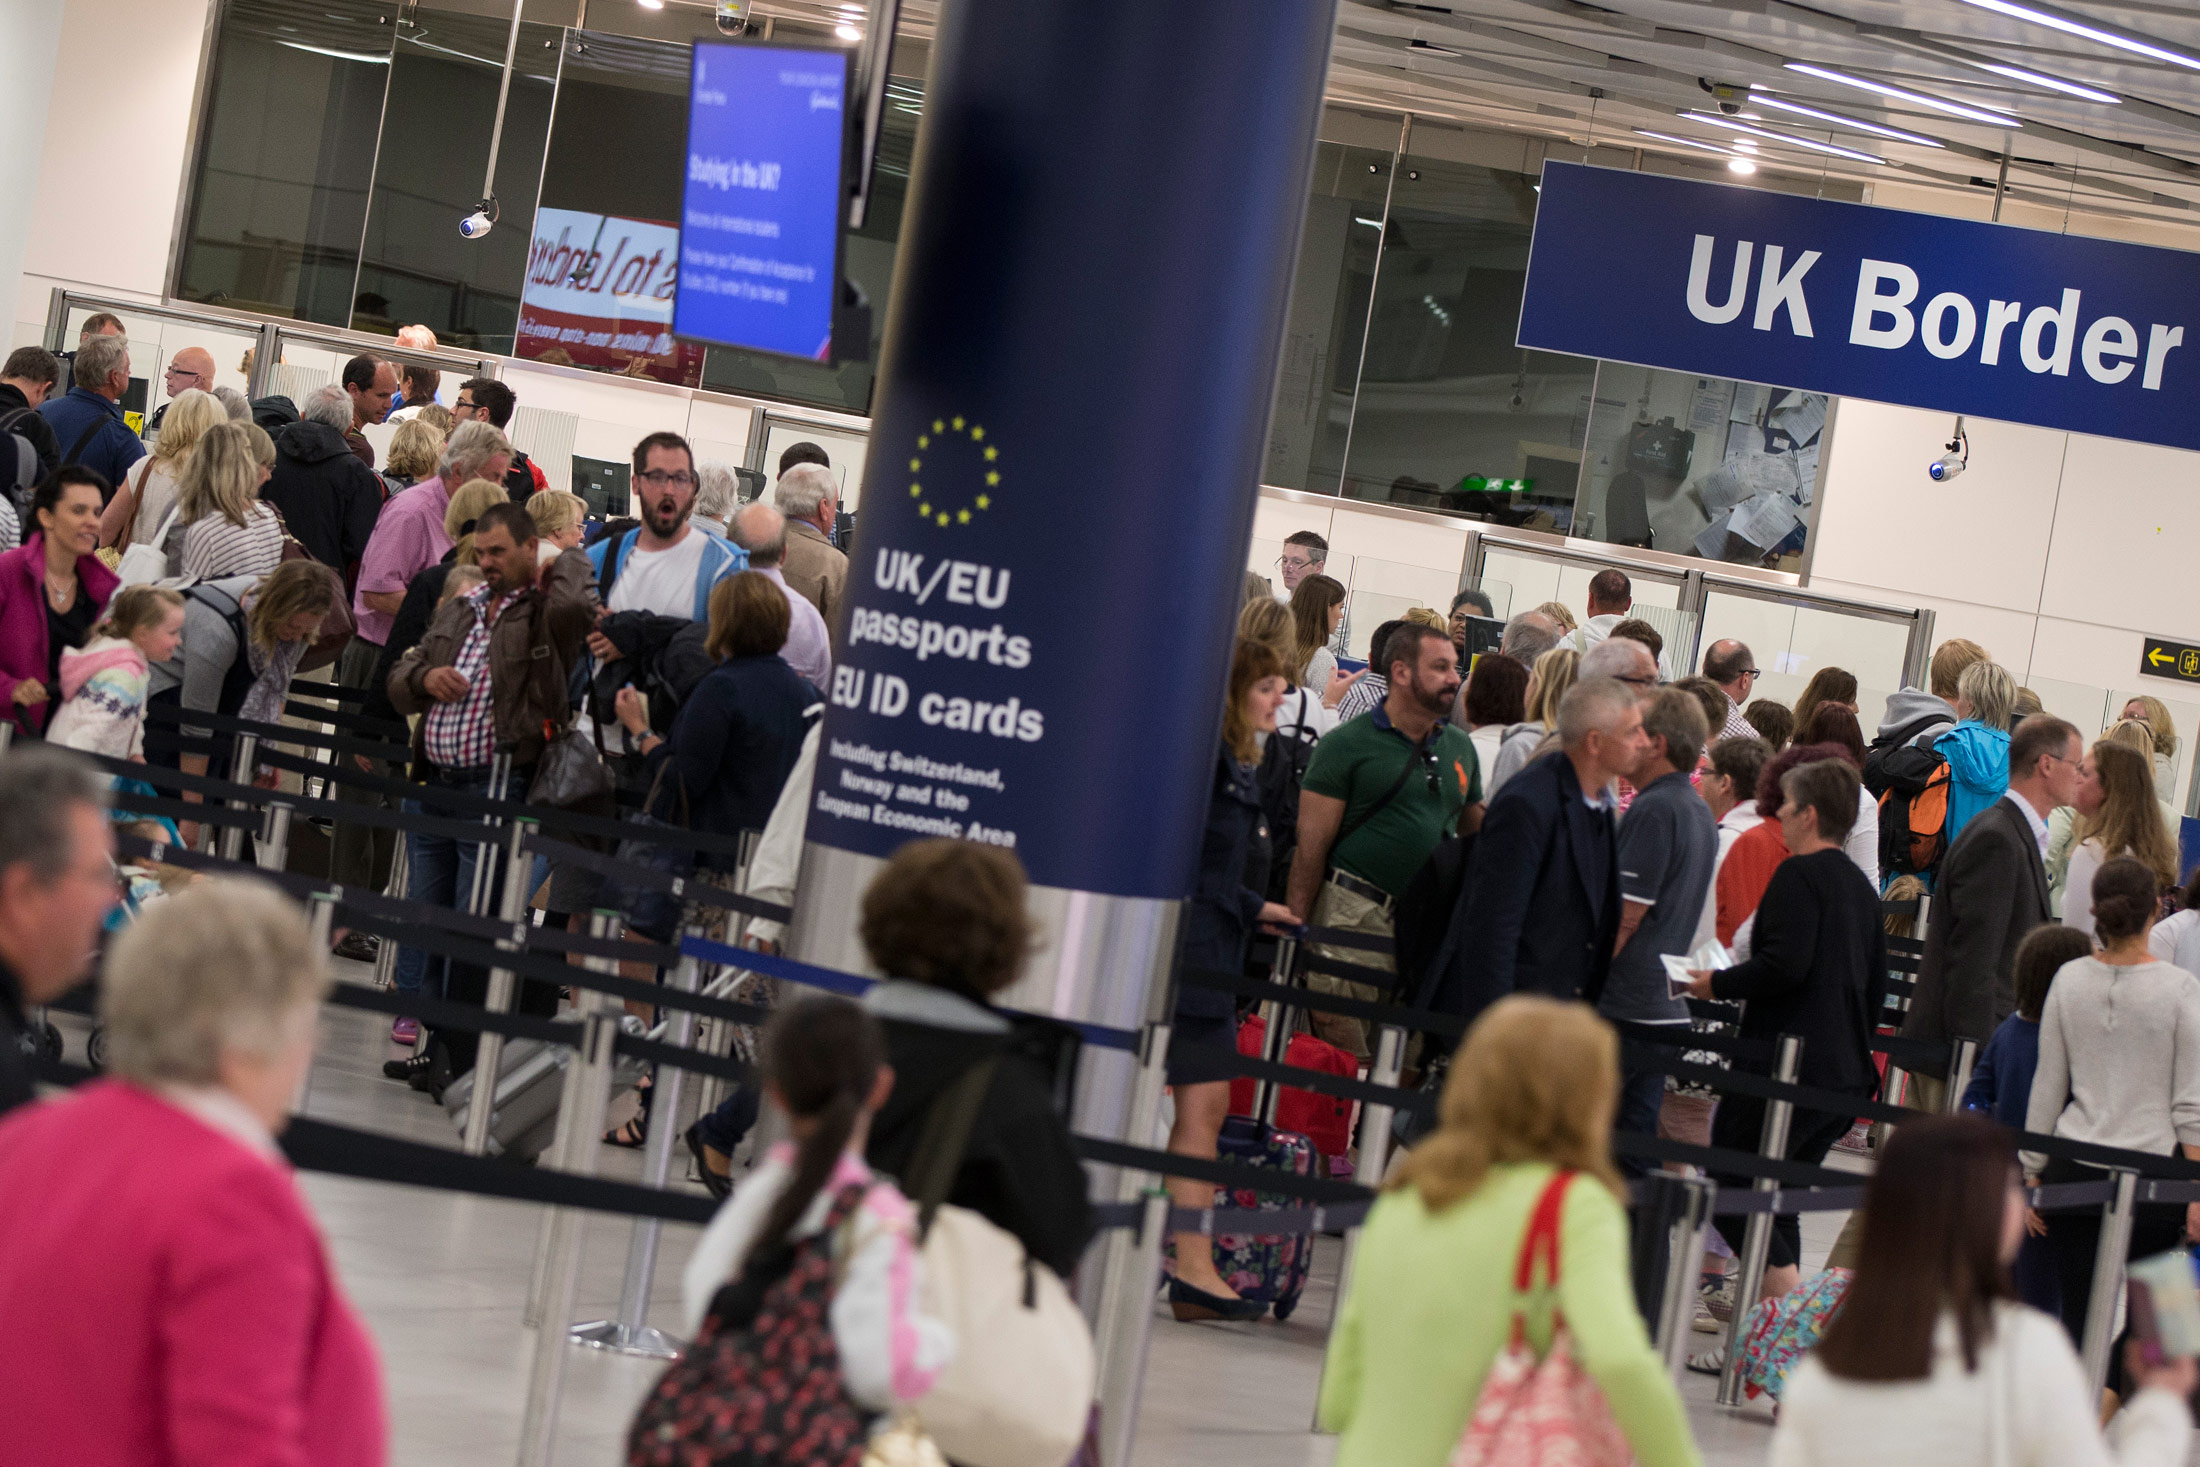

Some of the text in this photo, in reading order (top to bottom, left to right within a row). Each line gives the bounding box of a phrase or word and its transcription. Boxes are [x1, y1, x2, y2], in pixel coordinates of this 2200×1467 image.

[1686, 234, 2184, 391] UK Border
[875, 547, 1011, 609] UK/EU
[848, 606, 1032, 669] passports
[831, 664, 1045, 743] EU ID cards
[829, 737, 1005, 793] Including Switzerland,
[840, 767, 969, 812] Norway and the
[816, 790, 1017, 848] European Economic Area
